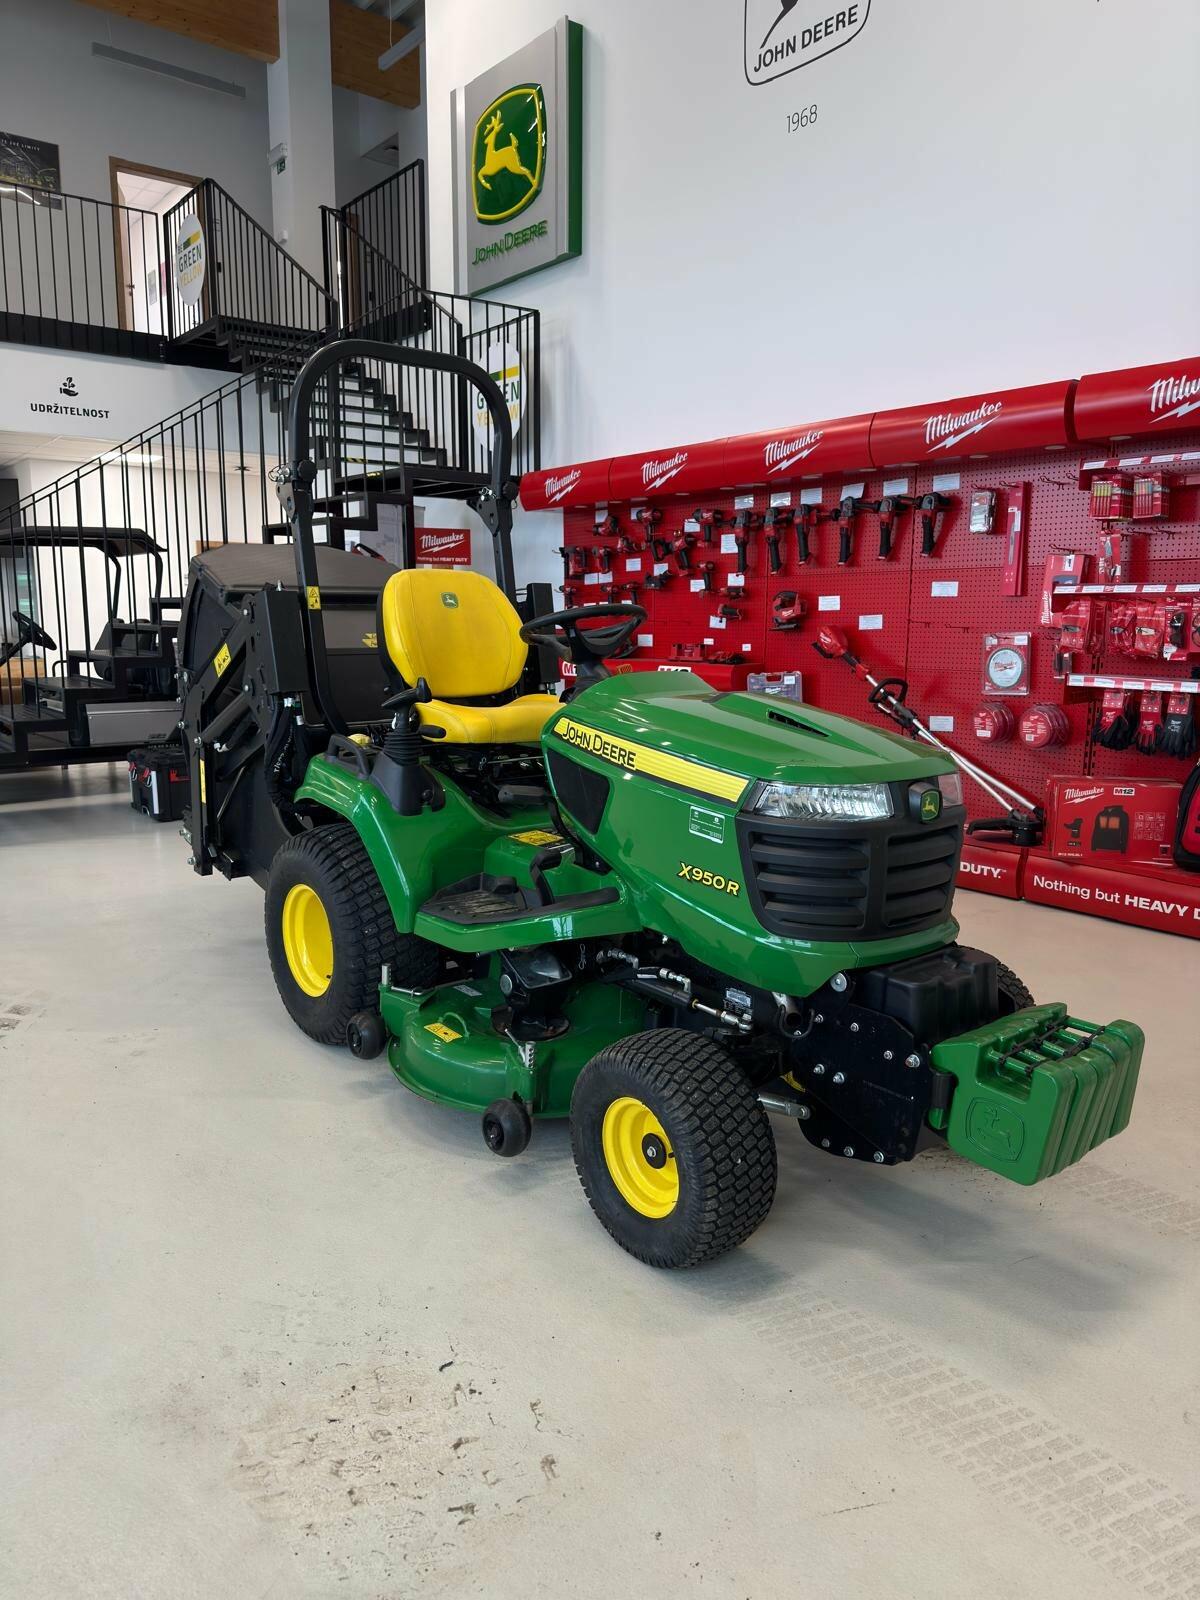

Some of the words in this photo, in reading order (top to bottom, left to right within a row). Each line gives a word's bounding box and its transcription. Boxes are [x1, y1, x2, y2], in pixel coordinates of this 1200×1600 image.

[754, 35, 797, 72] JOHN
[801, 4, 858, 49] DEERE
[786, 104, 818, 133] 1968
[472, 239, 504, 265] JOHN
[504, 220, 548, 251] DEERE
[179, 243, 202, 272] GREEN
[180, 262, 202, 288] YELLOW
[477, 381, 520, 409] GEN
[30, 402, 110, 419] UDRŽITELNOST
[923, 401, 1003, 444] Milwaukee
[763, 430, 824, 466] Milwaukee
[641, 452, 688, 484] Milwaukee
[544, 469, 582, 498] Milwaukee
[419, 532, 465, 549] Milwaukee
[563, 722, 591, 748] JOHN
[593, 734, 637, 768] DEERE
[1064, 787, 1104, 800] Milwaukee
[1033, 875, 1090, 900] Nothing
[1095, 888, 1121, 904] but
[1124, 894, 1189, 917] HEAVY
